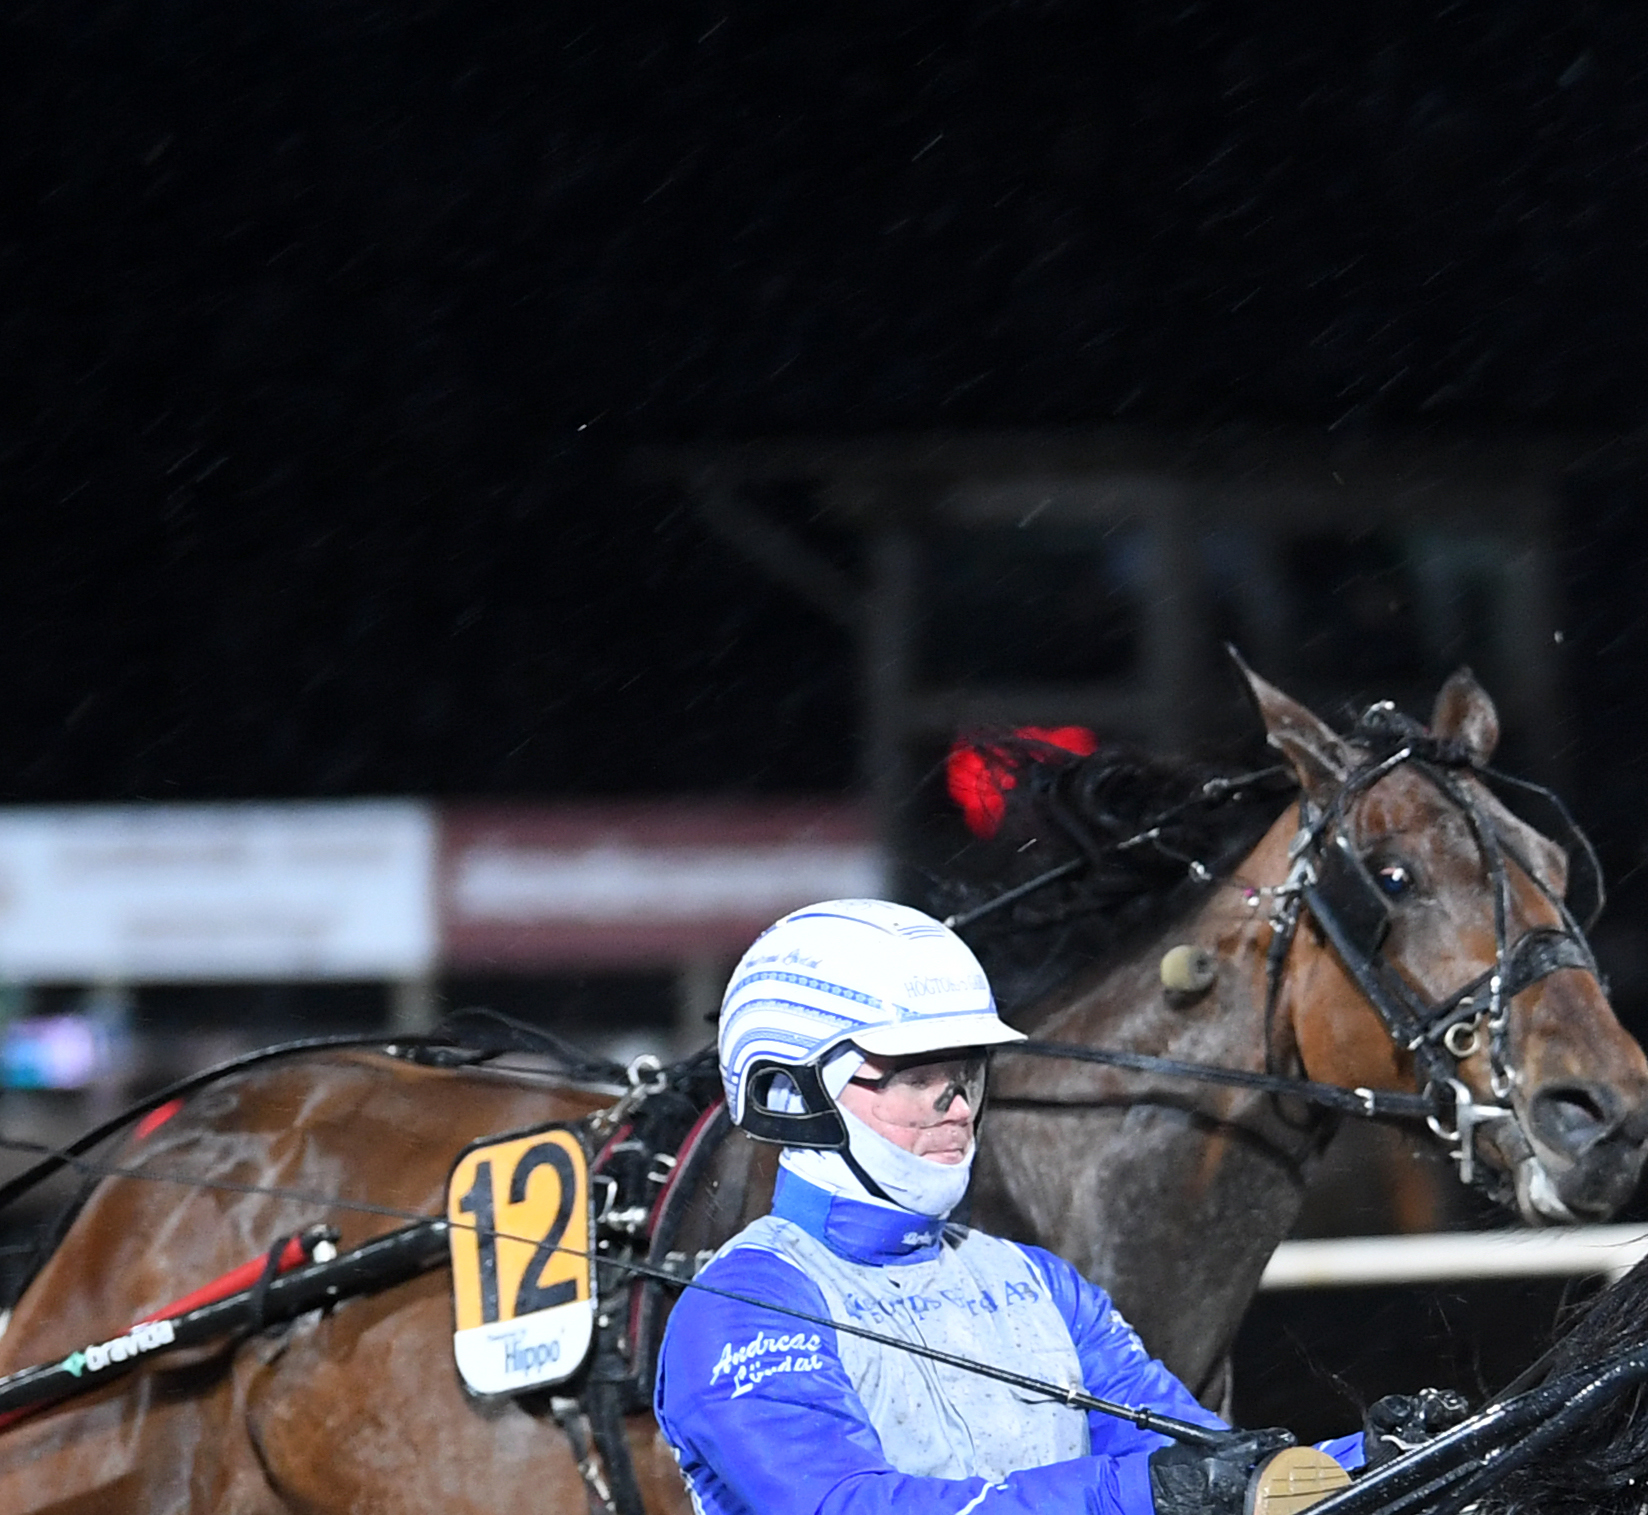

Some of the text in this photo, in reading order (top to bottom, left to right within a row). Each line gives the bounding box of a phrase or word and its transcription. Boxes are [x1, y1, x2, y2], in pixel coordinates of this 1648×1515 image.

[459, 1141, 578, 1325] 12
[504, 1339, 560, 1377] Hippo
[709, 1331, 822, 1386] Andreas
